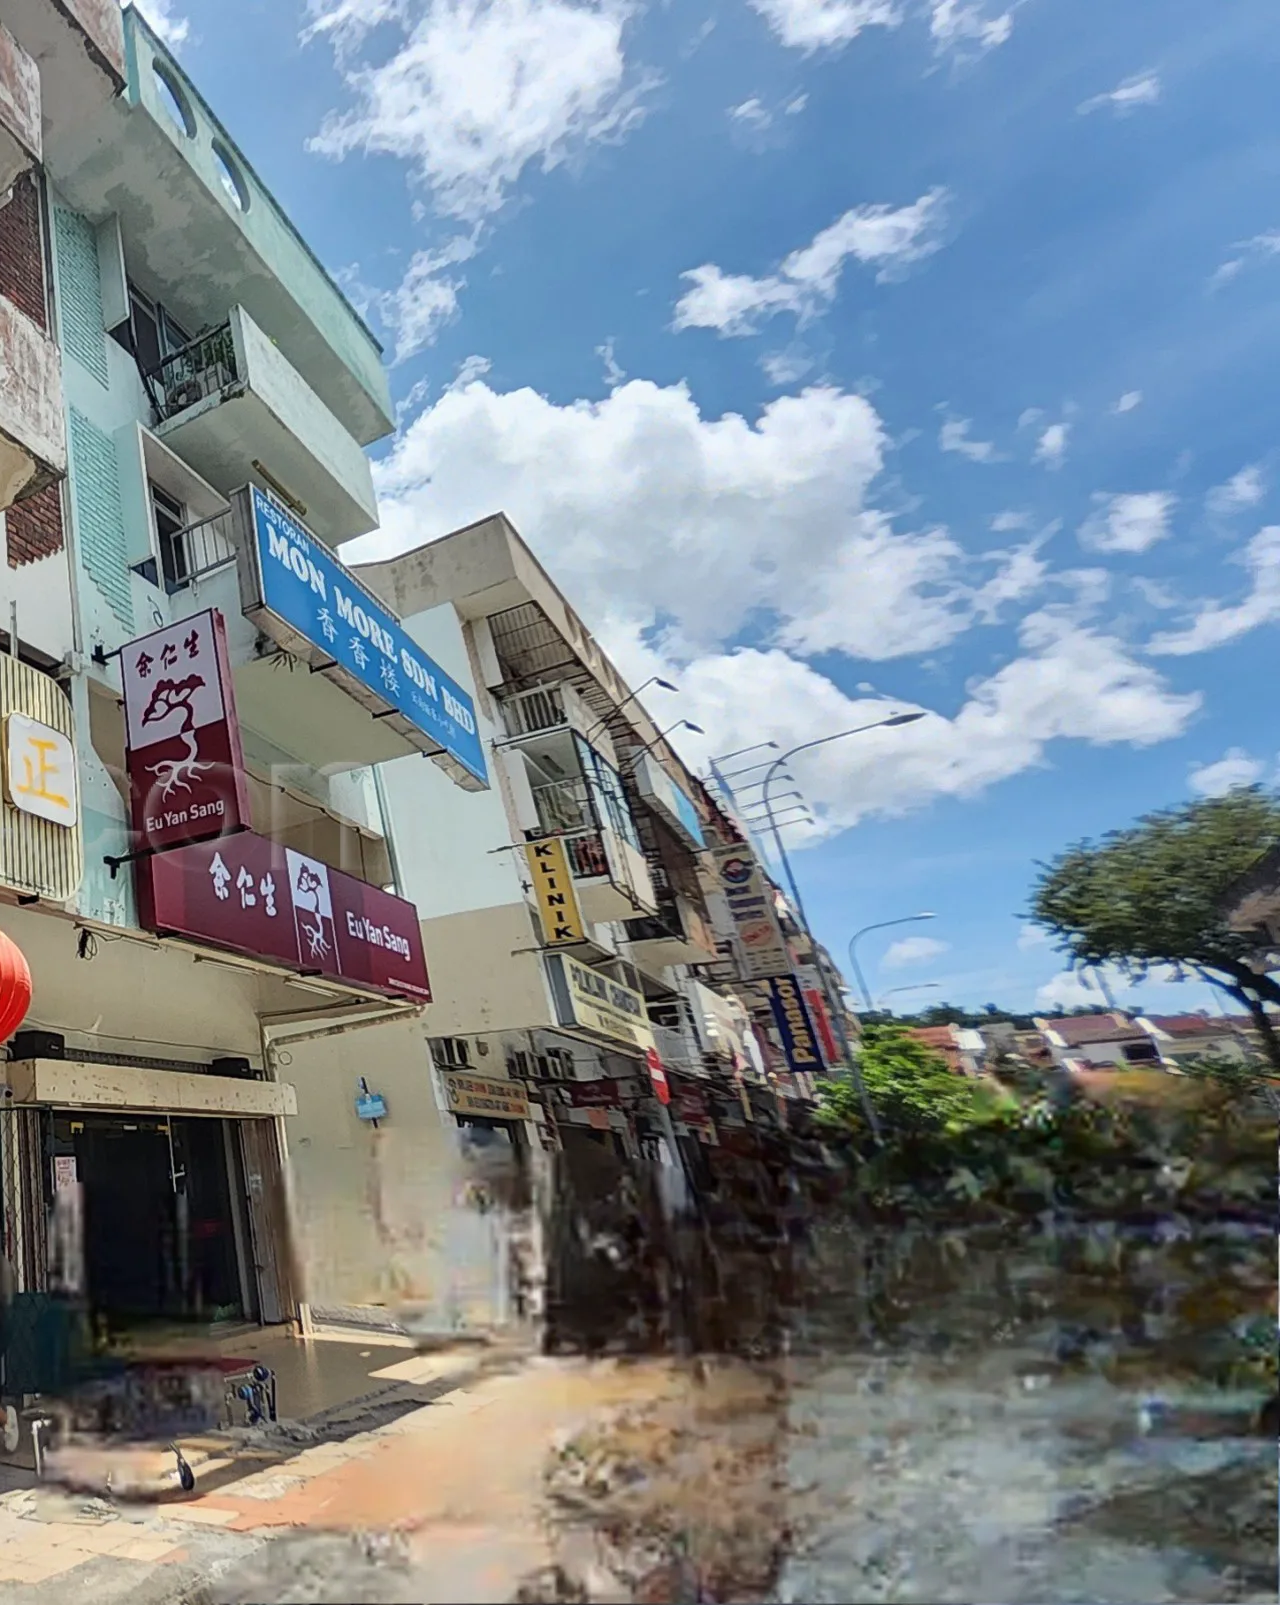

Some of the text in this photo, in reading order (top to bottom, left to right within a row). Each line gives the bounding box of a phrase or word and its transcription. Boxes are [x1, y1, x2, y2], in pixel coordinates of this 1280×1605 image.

[256, 495, 310, 556] RESTORAN
[265, 521, 327, 602] MON
[333, 585, 399, 665] MORE
[401, 647, 439, 702] SDN
[440, 685, 476, 736] BHD
[16, 736, 69, 808] 正
[146, 800, 225, 833] Eu Yan Sang
[534, 843, 576, 939] KLINIK
[345, 910, 412, 962] Eu Yan Sang
